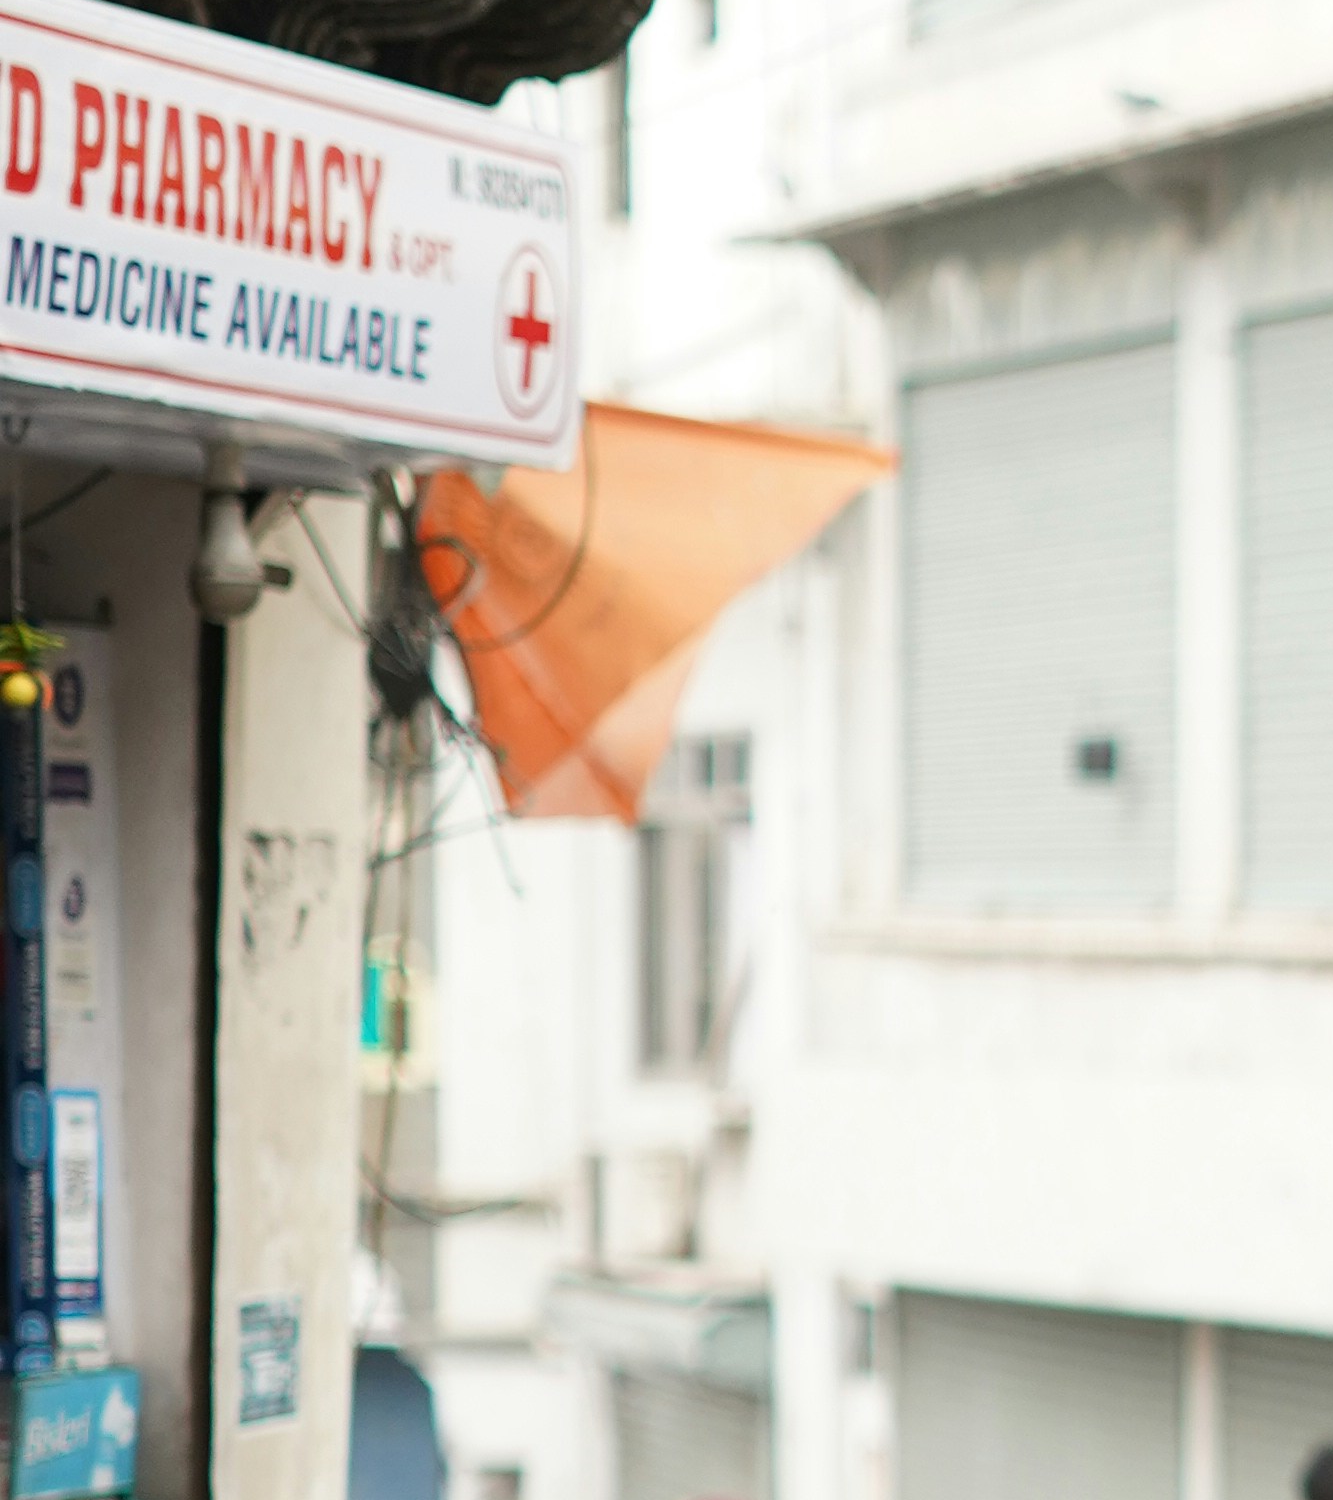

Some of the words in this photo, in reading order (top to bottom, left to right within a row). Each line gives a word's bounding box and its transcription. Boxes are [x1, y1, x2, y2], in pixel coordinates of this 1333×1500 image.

[0, 63, 43, 194] D
[70, 81, 382, 269] PHARMACY
[5, 235, 214, 341] MEDICINE
[226, 282, 434, 381] AVAILABLE
